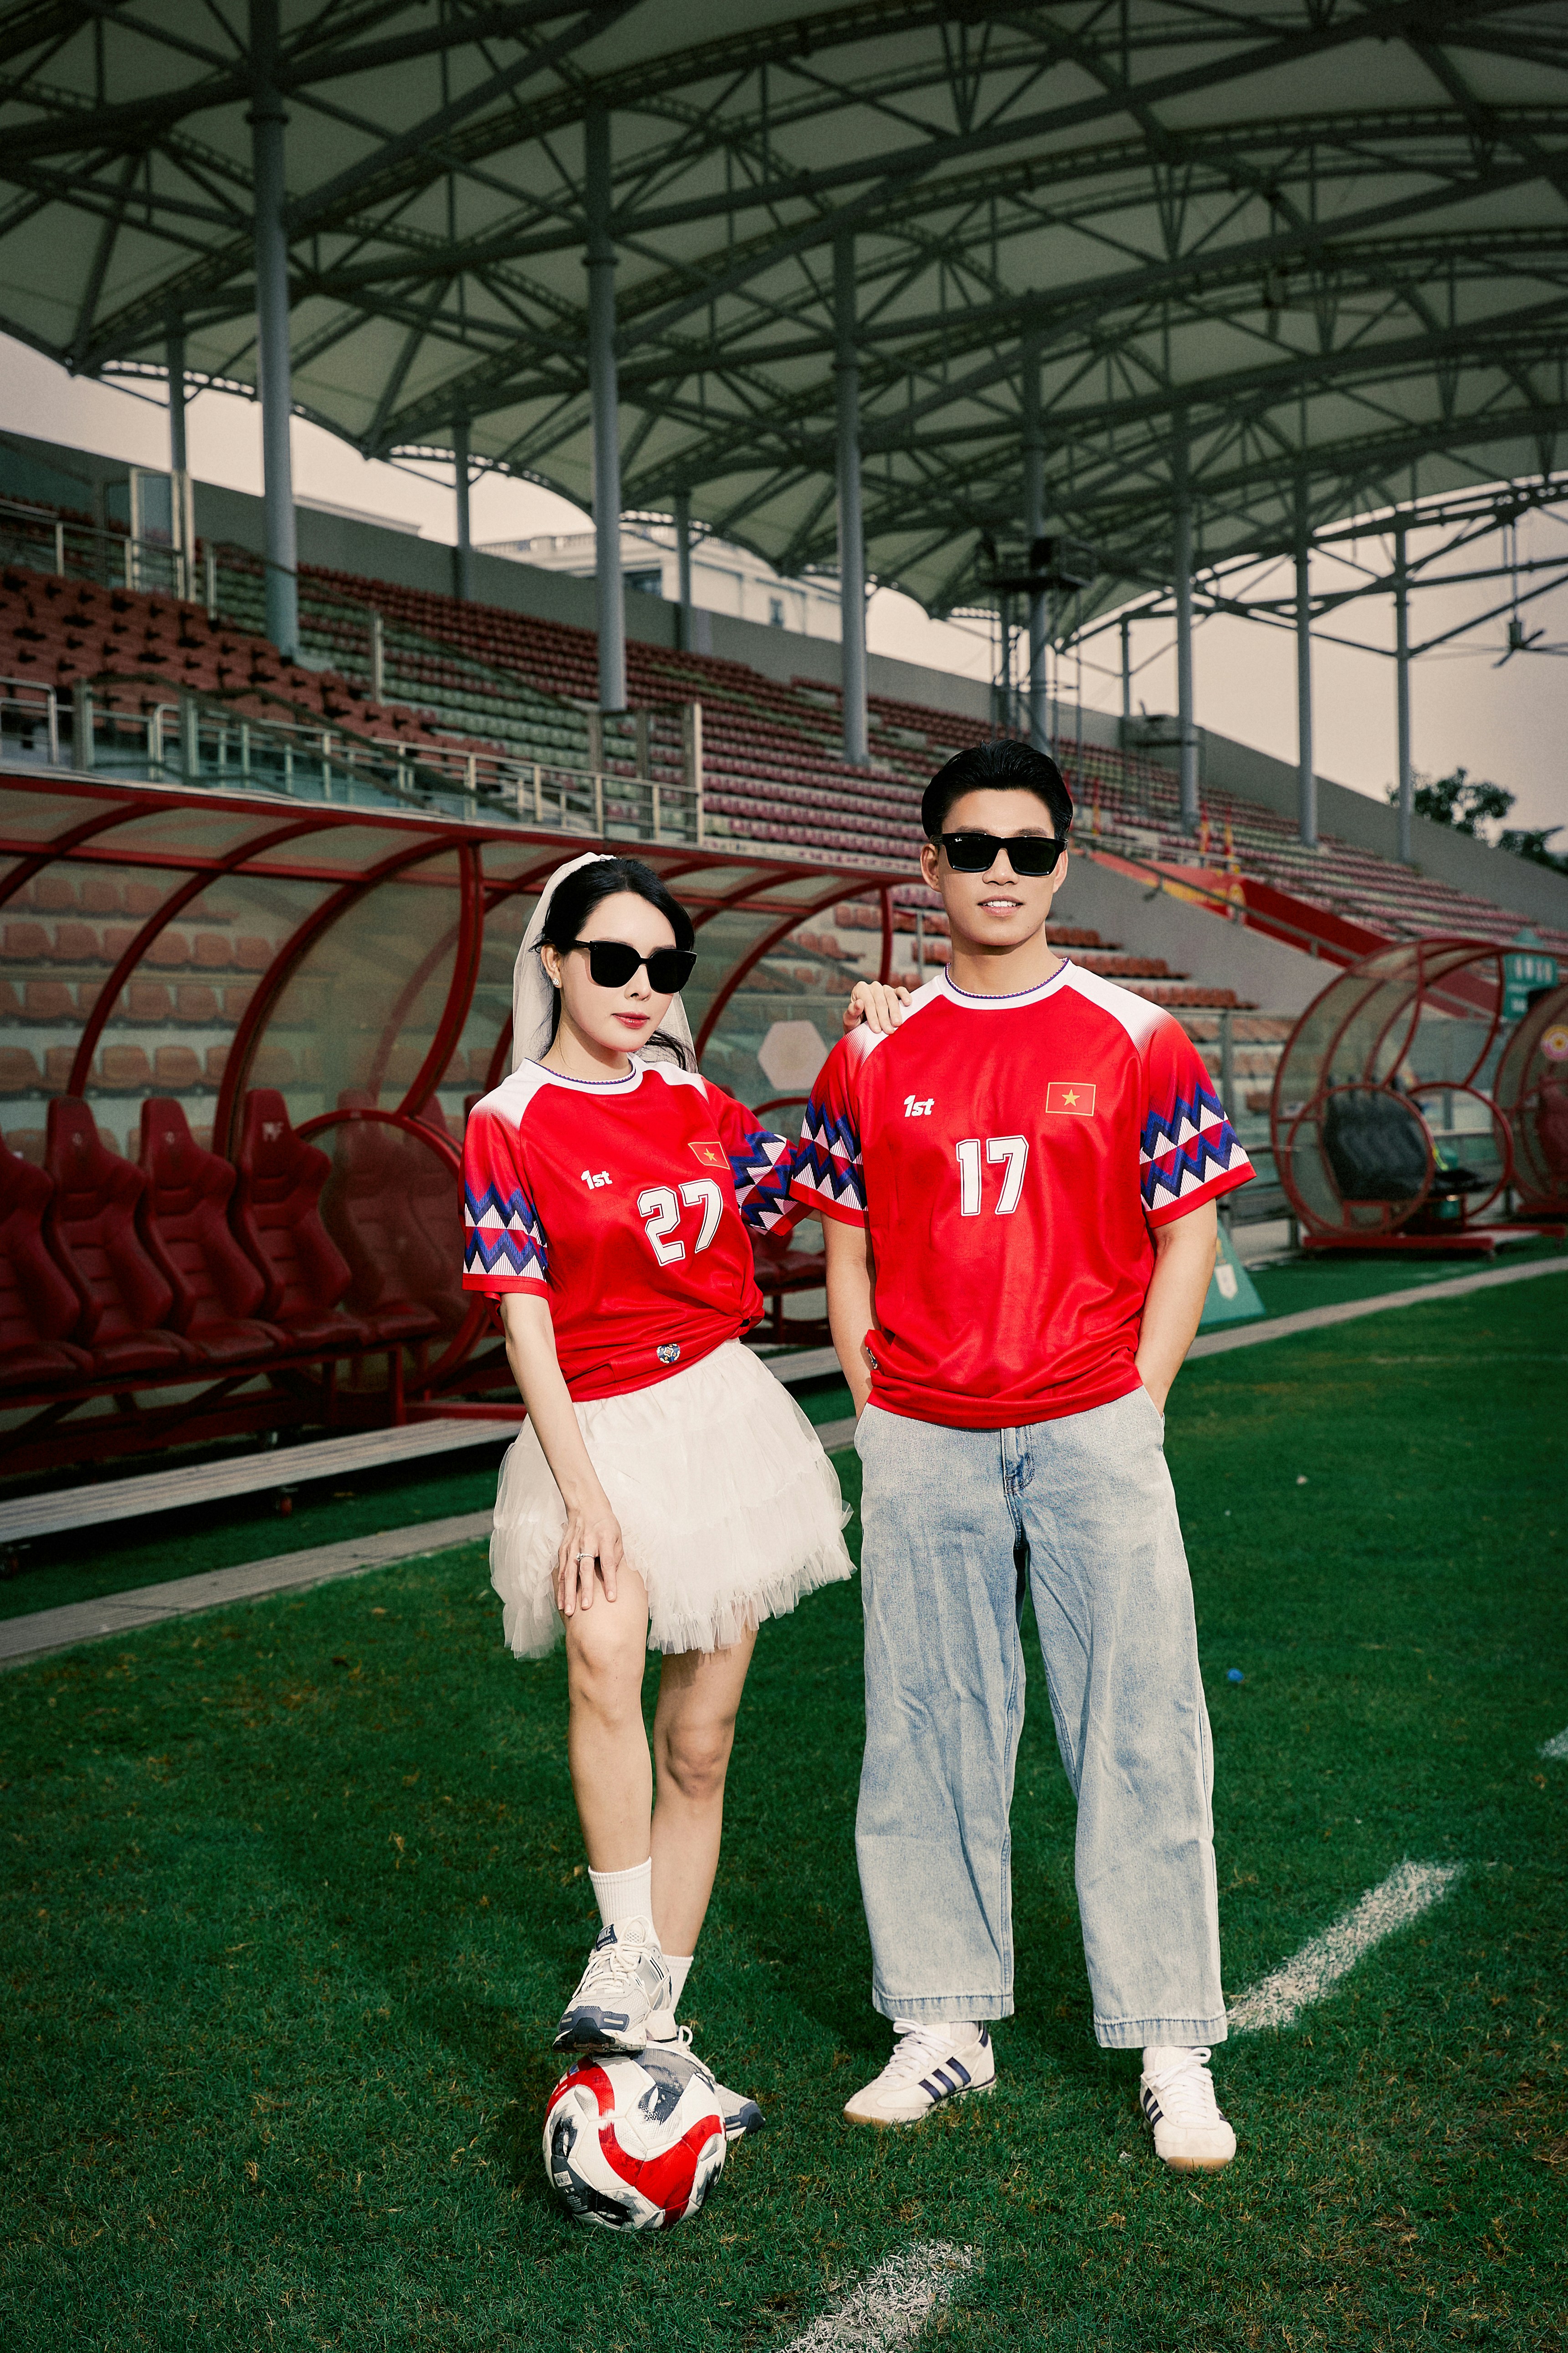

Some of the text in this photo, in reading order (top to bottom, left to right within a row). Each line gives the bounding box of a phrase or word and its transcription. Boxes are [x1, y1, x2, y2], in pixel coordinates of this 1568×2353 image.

[904, 1095, 934, 1117] 1st
[581, 1170, 612, 1190] 1st
[956, 1135, 1029, 1217] 17
[637, 1178, 723, 1266] 27
[597, 1926, 611, 1943] NIKE
